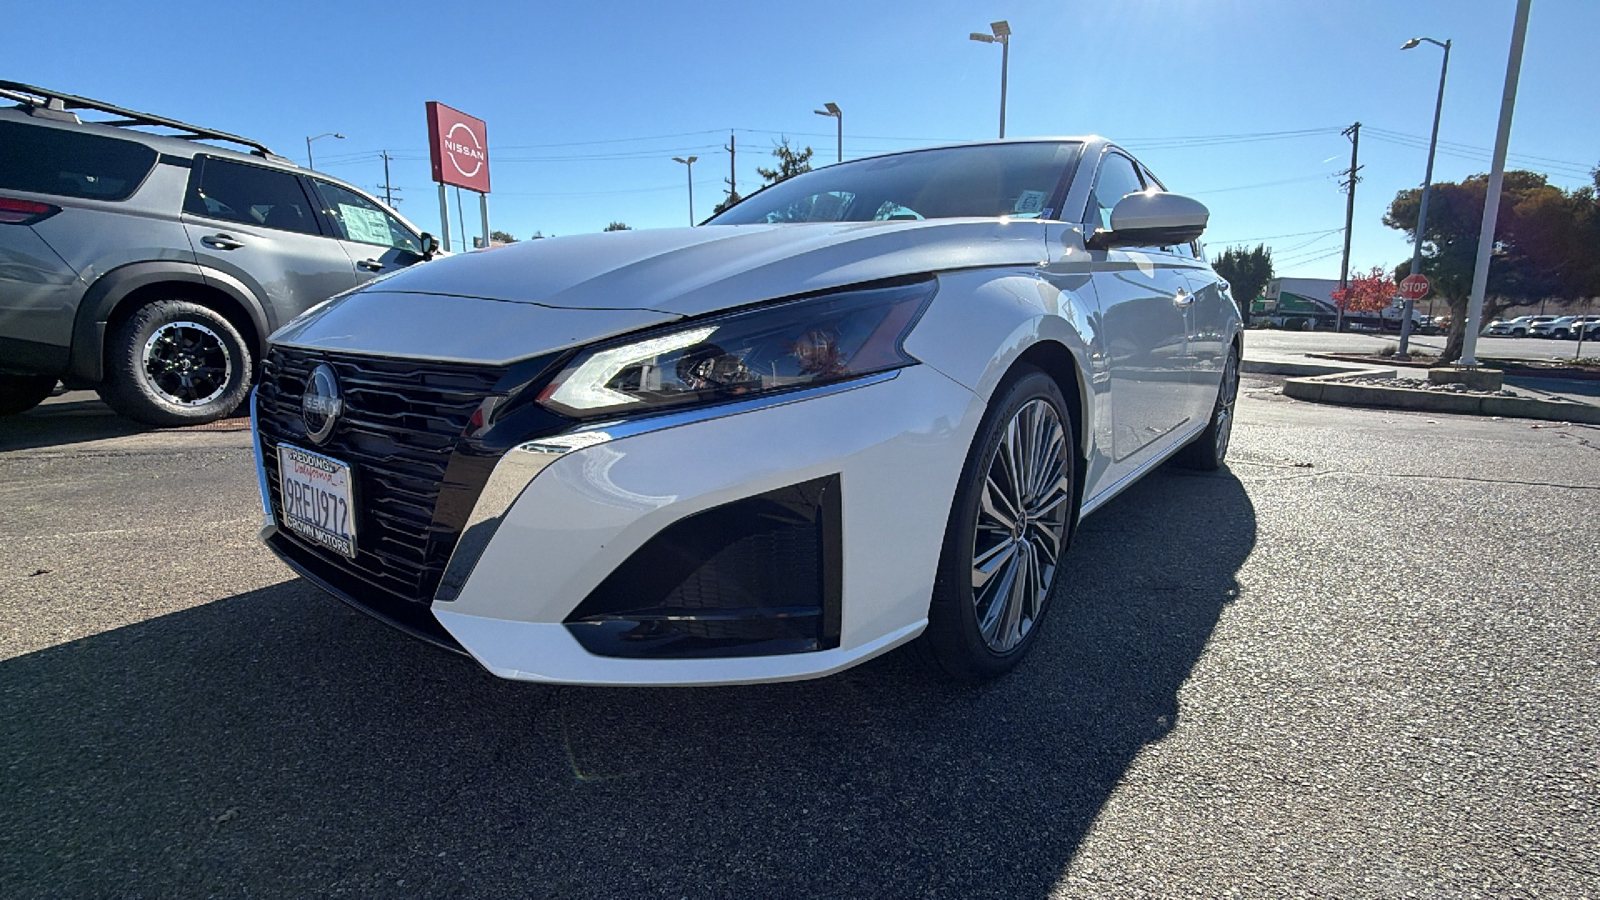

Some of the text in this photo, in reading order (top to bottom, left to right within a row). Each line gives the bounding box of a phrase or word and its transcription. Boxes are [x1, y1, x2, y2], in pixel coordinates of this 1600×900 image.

[445, 139, 484, 160] NISSAN
[1401, 282, 1428, 293] STOP
[292, 450, 330, 471] REDDING
[294, 460, 334, 483] California
[286, 477, 349, 539] 9REU972
[287, 516, 349, 554] CROWN MOTORS
